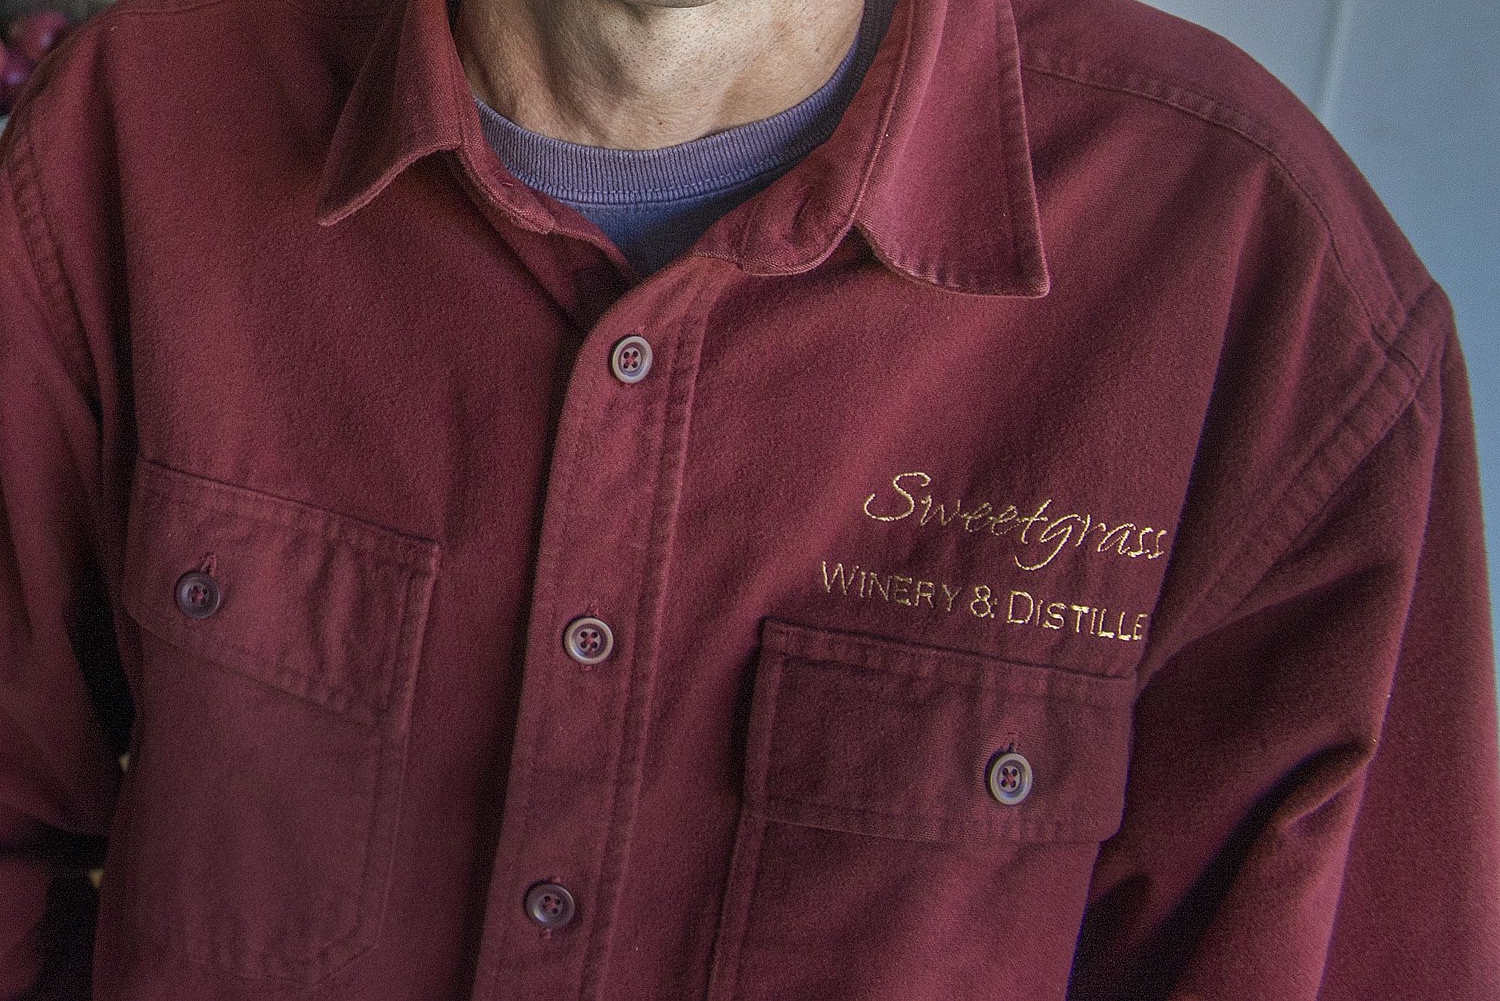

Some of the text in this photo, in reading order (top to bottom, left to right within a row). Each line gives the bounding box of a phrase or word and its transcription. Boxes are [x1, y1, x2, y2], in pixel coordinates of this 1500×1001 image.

[863, 471, 1169, 572] Sweetgrass
[820, 560, 963, 612] WINERY
[970, 584, 998, 619] &
